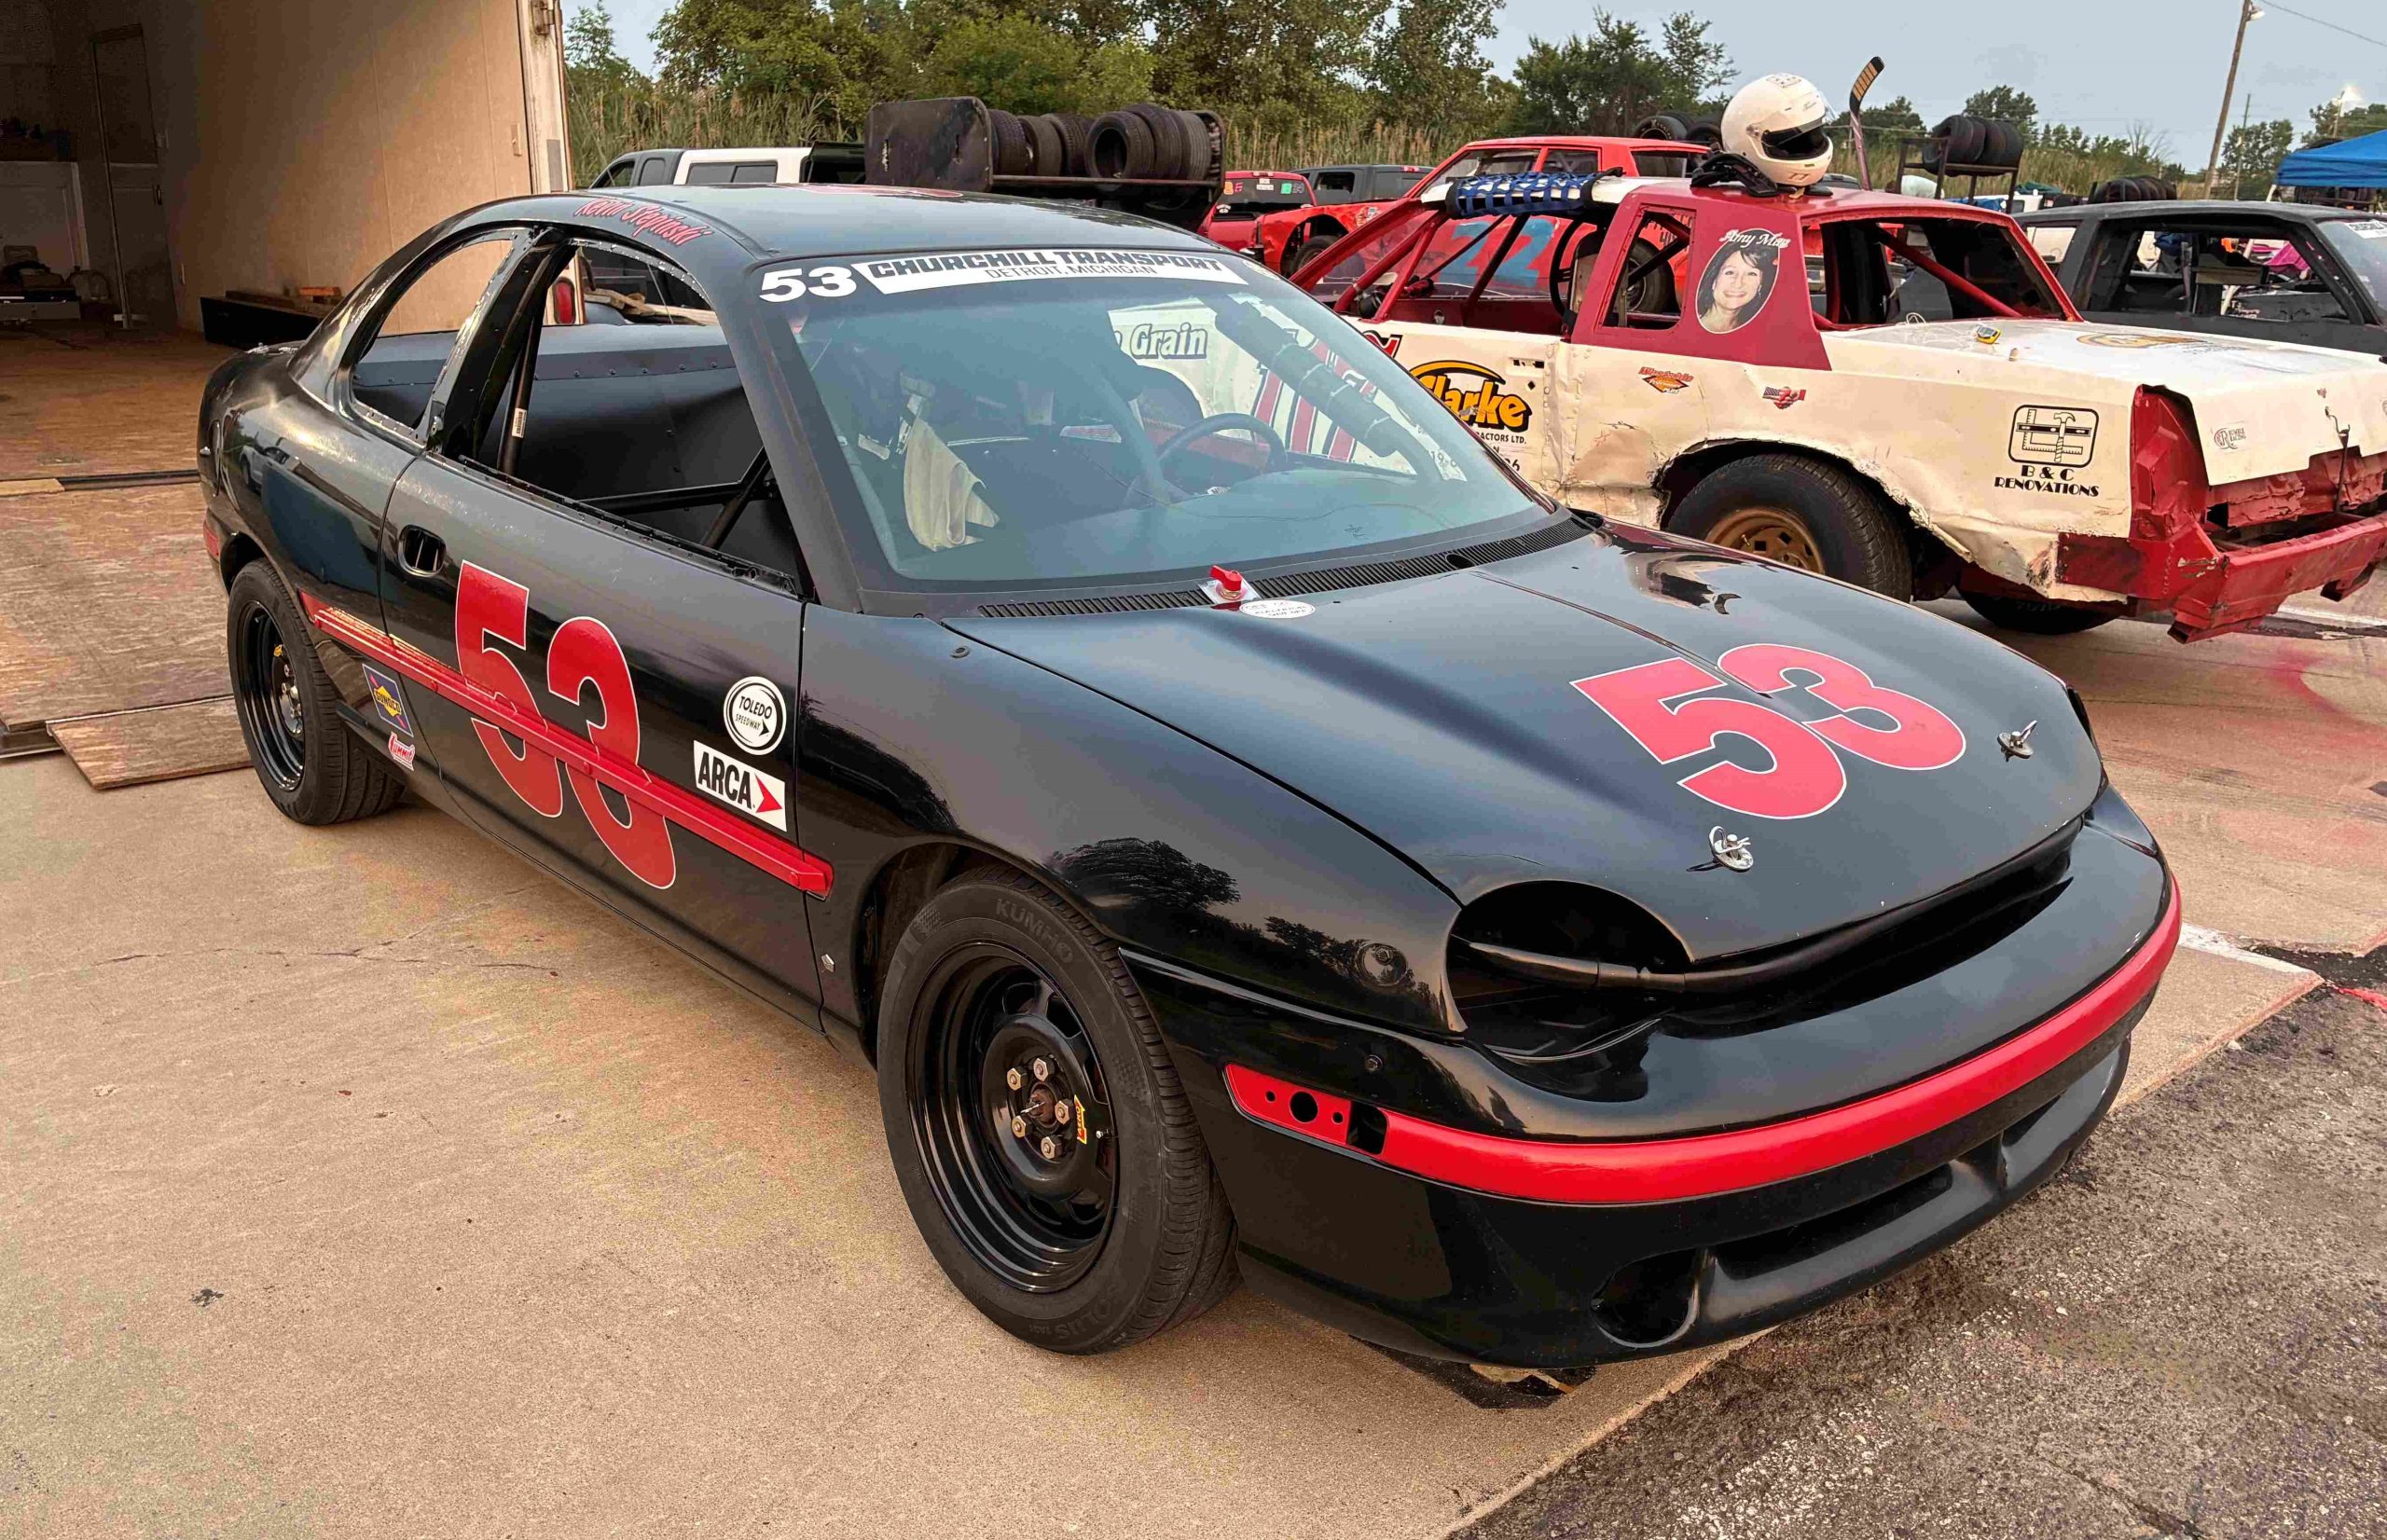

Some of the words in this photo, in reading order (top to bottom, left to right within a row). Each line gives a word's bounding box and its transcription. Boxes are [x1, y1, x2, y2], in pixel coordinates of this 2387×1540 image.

[1718, 229, 1756, 248] Amy
[868, 252, 1056, 279] CHURCHILL
[1053, 251, 1223, 271] TRANSPORT
[1067, 265, 1158, 275] MICHIGAN
[759, 267, 857, 303] 53
[1130, 322, 1207, 360] Grain
[1511, 435, 1526, 444] LTD.
[2021, 464, 2035, 477] B
[2039, 466, 2054, 479] &
[2060, 468, 2075, 481] C
[1994, 476, 2100, 497] RENOVATIONS
[375, 692, 402, 713] SUNOCO
[739, 695, 772, 720] TOLEDO
[455, 559, 676, 889] 53
[735, 713, 761, 731] SPEEDWAY
[1569, 643, 1966, 819] 53
[697, 750, 752, 810] ARCA
[996, 898, 1073, 963] KUMHO
